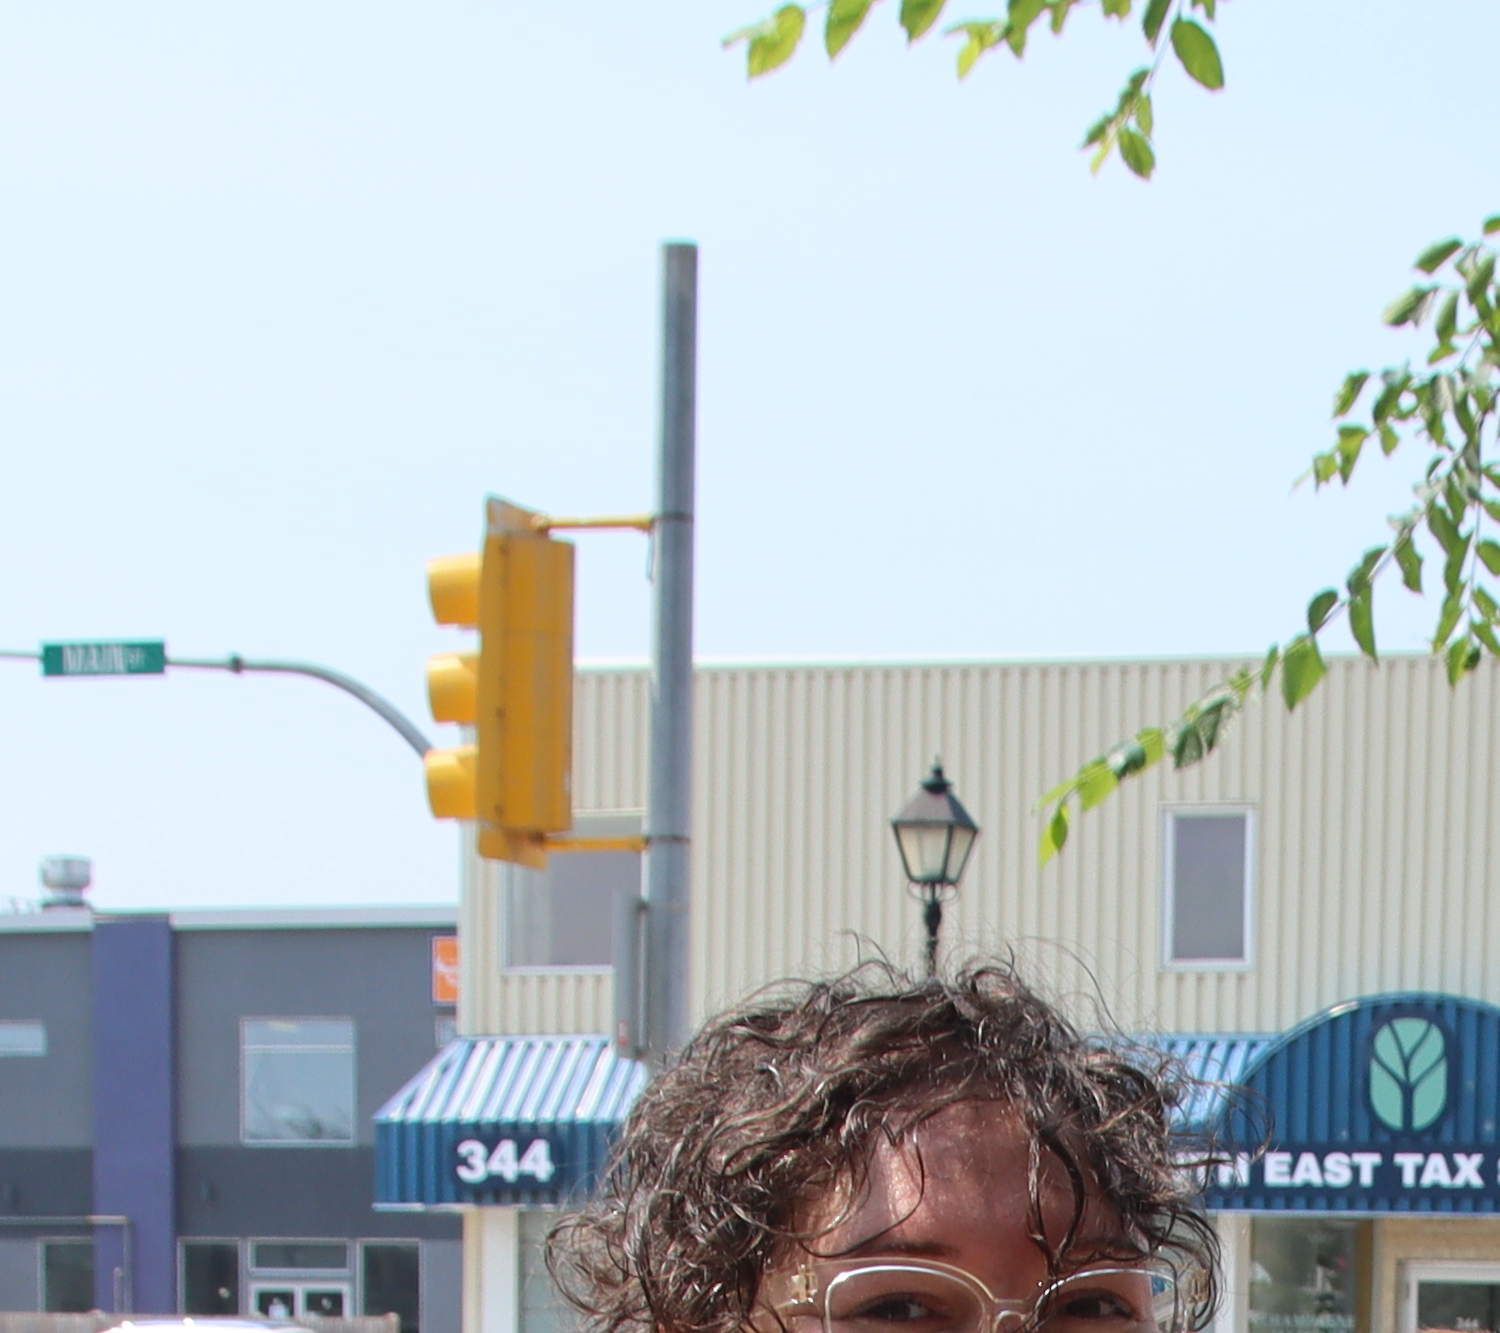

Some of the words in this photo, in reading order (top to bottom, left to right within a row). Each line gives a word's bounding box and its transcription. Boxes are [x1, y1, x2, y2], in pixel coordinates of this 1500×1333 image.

[456, 1138, 555, 1184] 344
[1263, 1151, 1381, 1189] EAST
[1394, 1152, 1484, 1189] TAX
